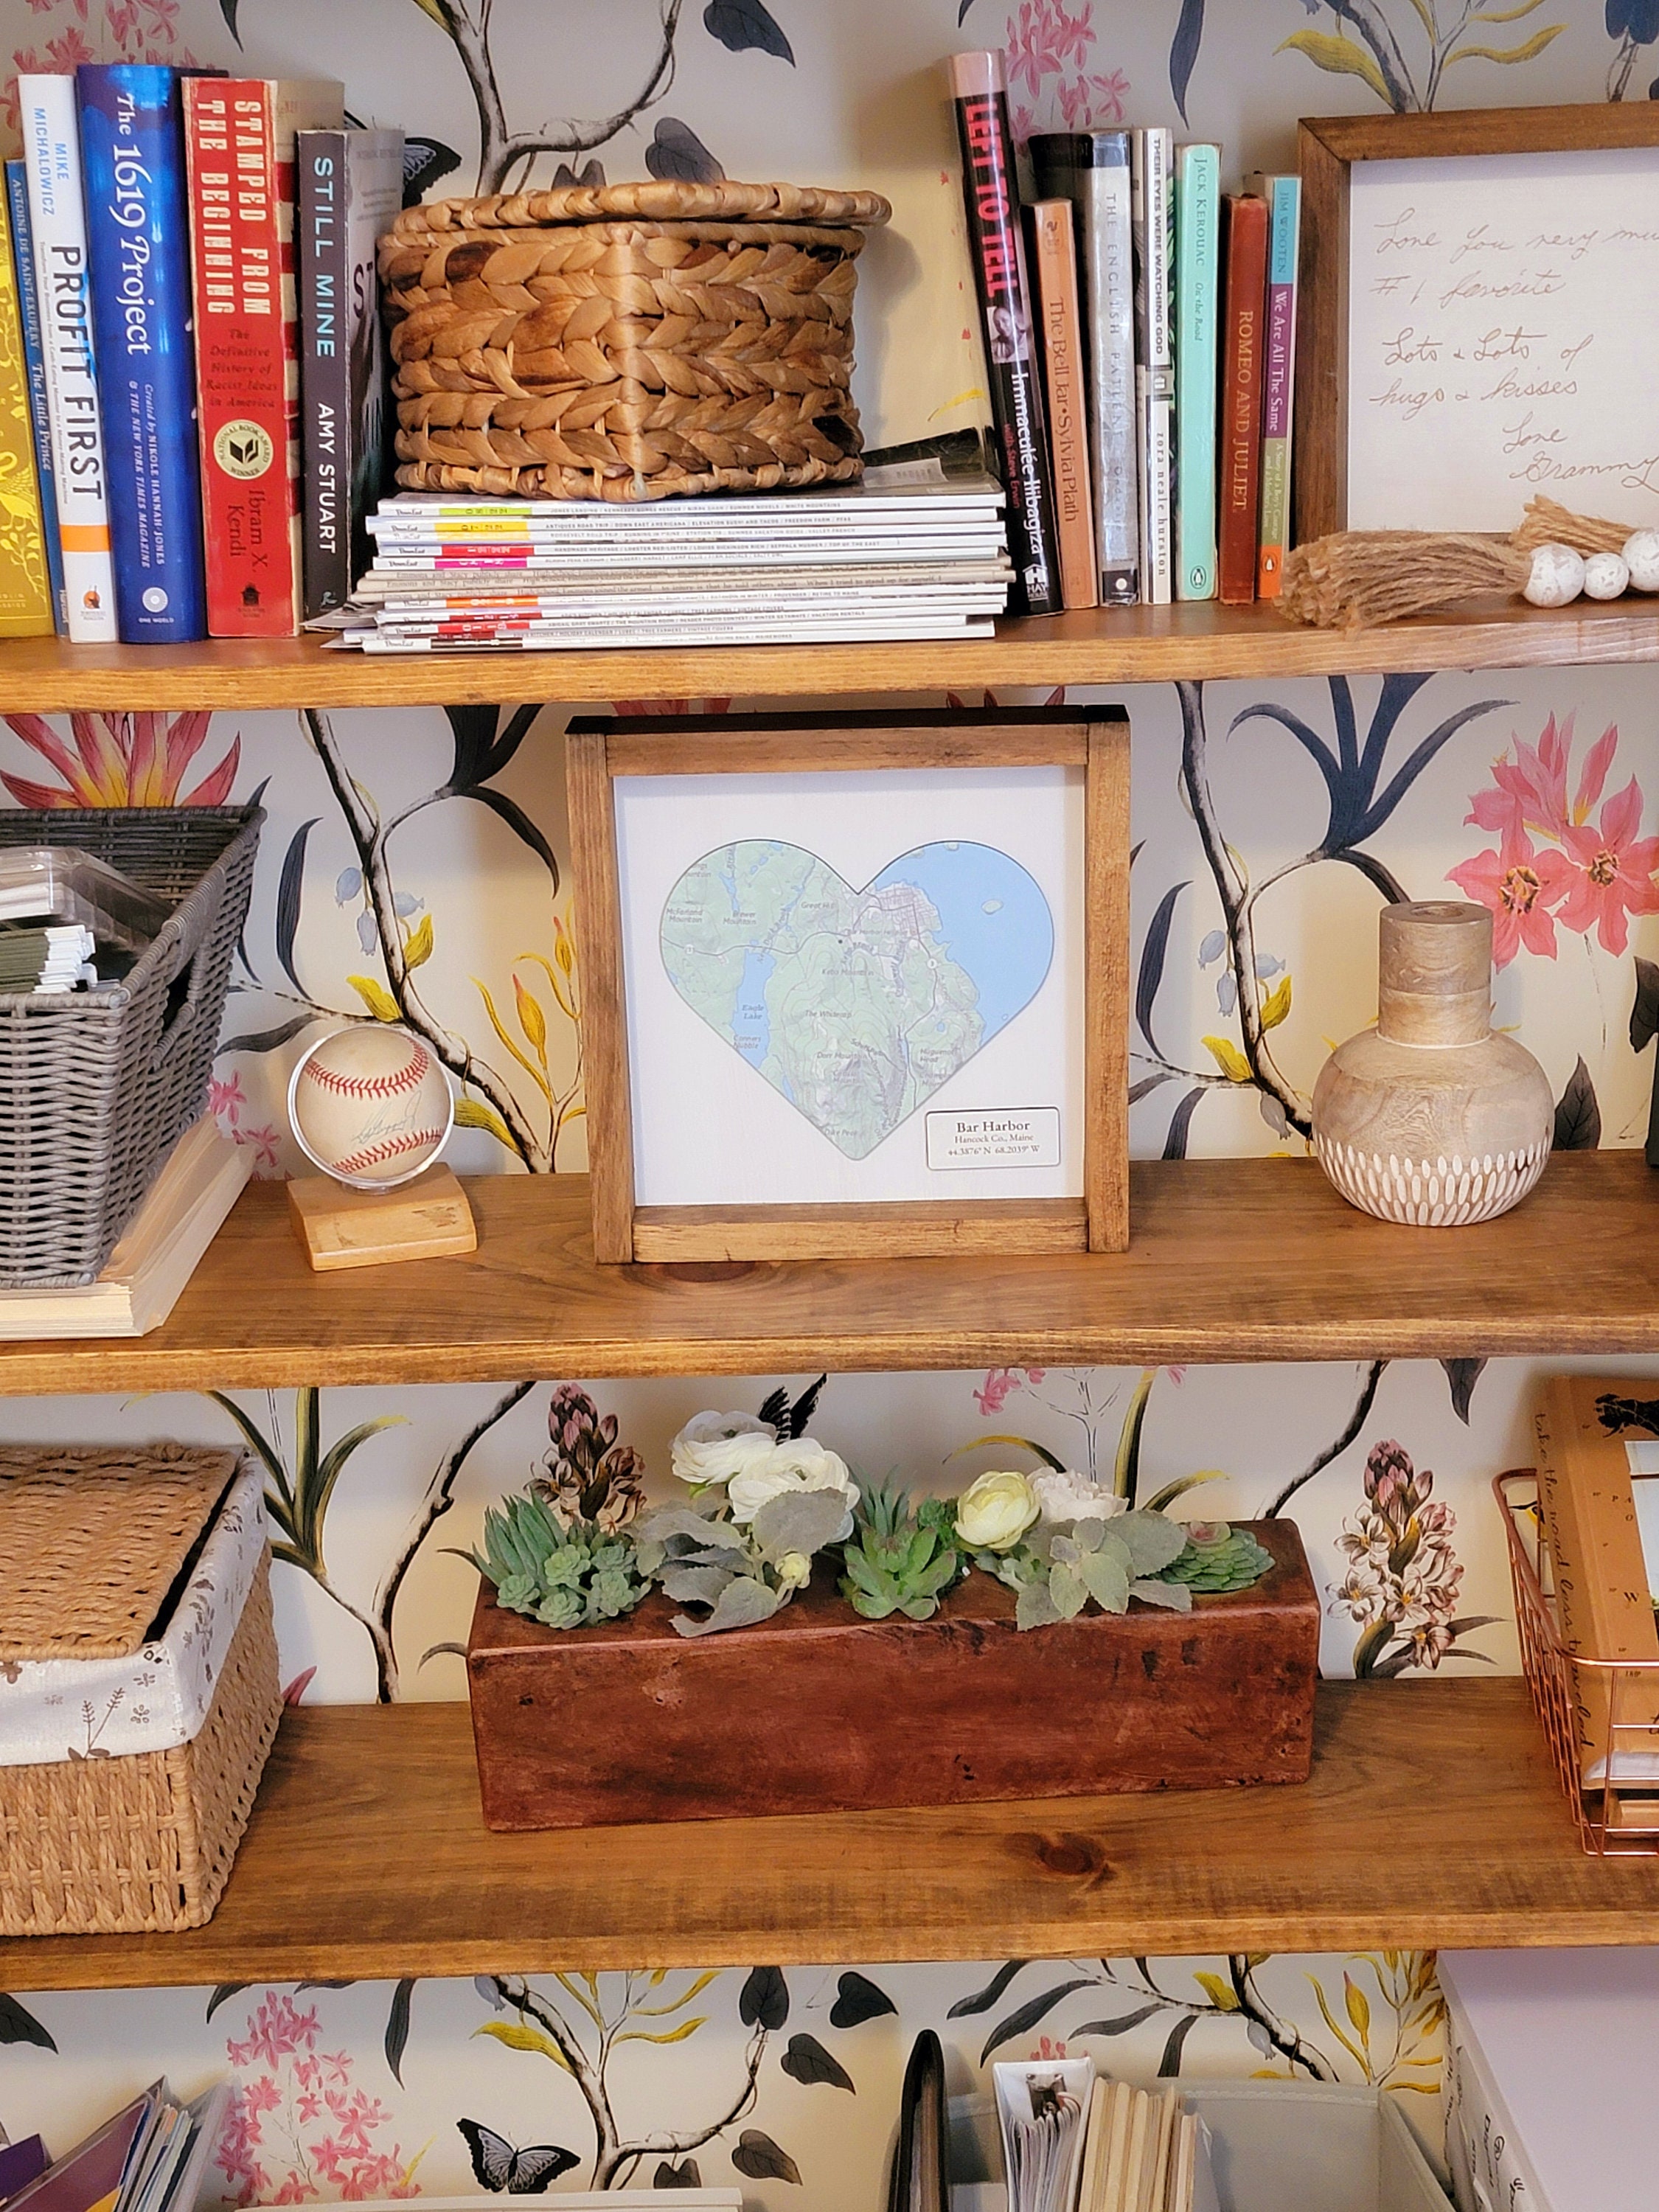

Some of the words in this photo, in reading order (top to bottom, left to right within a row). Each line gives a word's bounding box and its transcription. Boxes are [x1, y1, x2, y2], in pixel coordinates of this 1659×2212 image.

[116, 93, 135, 136] The
[198, 100, 228, 150] THE
[966, 102, 1004, 170] LEFT
[34, 108, 55, 215] MICHALOWICZ
[55, 142, 69, 180] MIKE
[234, 100, 267, 221] STAMPED
[1153, 138, 1161, 175] THEIR
[1194, 158, 1208, 192] JACK
[108, 145, 153, 227] 1619
[975, 177, 1010, 221] TO
[1154, 182, 1162, 212] EYES
[1279, 191, 1290, 212] JIM
[13, 179, 28, 234] ANTOINE
[314, 156, 334, 258] STILL
[1106, 193, 1117, 228] THE
[18, 238, 29, 253] DE
[201, 172, 235, 313] BEGINNING
[1155, 215, 1163, 251] WERE
[1195, 198, 1207, 266] KEROUAC
[1277, 216, 1289, 274] WOOTEN
[240, 248, 271, 314] FROM
[981, 226, 1018, 298] TELL
[115, 235, 154, 355] Project
[1107, 244, 1120, 335] ENGLISH
[1155, 254, 1164, 324] WATCHING
[1194, 282, 1204, 296] On
[1194, 299, 1203, 314] the
[1273, 291, 1287, 312] We
[1440, 268, 1568, 309] favorite
[50, 246, 91, 378] PROFIT
[316, 274, 335, 358] MINE
[1049, 296, 1065, 335] The
[1194, 317, 1203, 341] Road
[1273, 316, 1286, 340] Are
[1051, 340, 1070, 376] Bell
[1155, 327, 1164, 355] GOD
[1238, 310, 1253, 383] ROMEO
[1272, 344, 1286, 363] All
[1382, 326, 1443, 366] Lots
[1474, 326, 1548, 362] Lots
[1560, 334, 1594, 372] of
[32, 364, 44, 389] The
[1054, 380, 1070, 406] Jar
[1270, 368, 1284, 394] The
[1369, 377, 1445, 421] hugs
[1481, 366, 1578, 402] kisses
[35, 393, 49, 426] Little
[130, 392, 140, 414] THE
[144, 383, 156, 420] Created
[1236, 389, 1251, 433] AND
[1269, 397, 1283, 432] Same
[132, 417, 142, 442] NEW
[145, 422, 155, 433] by
[318, 403, 335, 454] AMY
[1004, 423, 1015, 448] with
[1011, 372, 1039, 476] Immaculée
[1057, 414, 1076, 473] Sylvia
[39, 430, 52, 470] Prince
[63, 397, 102, 500] FIRST
[133, 445, 144, 473] YORK
[147, 435, 160, 476] NIKOLE
[1006, 450, 1018, 478] Steve
[1157, 433, 1166, 463] zora
[1275, 451, 1284, 472] Story
[136, 476, 146, 509] TIMES
[1010, 480, 1021, 509] Erwin
[1158, 472, 1168, 511] neale
[1275, 473, 1283, 481] of
[248, 490, 266, 545] Ibram
[318, 463, 336, 554] STUART
[1022, 479, 1046, 554] Ilibagiza
[1062, 477, 1080, 522] Plath
[138, 512, 150, 568] MAGAZINE
[150, 479, 164, 565] HANNAH-JONES
[227, 504, 247, 557] Kendi
[1271, 509, 1281, 540] Courage
[1158, 518, 1167, 577] hurston
[742, 1004, 765, 1012] Eagle
[954, 1135, 990, 1144] Hancock
[991, 1134, 1007, 1143] Co.,
[1009, 1133, 1034, 1142] Maine
[956, 1121, 979, 1133] Bar
[983, 1120, 1031, 1132] Harbor
[1031, 1144, 1040, 1153] W
[1534, 1413, 1551, 1464] take
[1543, 1470, 1558, 1504] the
[1548, 1511, 1571, 1569] road
[1559, 1578, 1574, 1632] less
